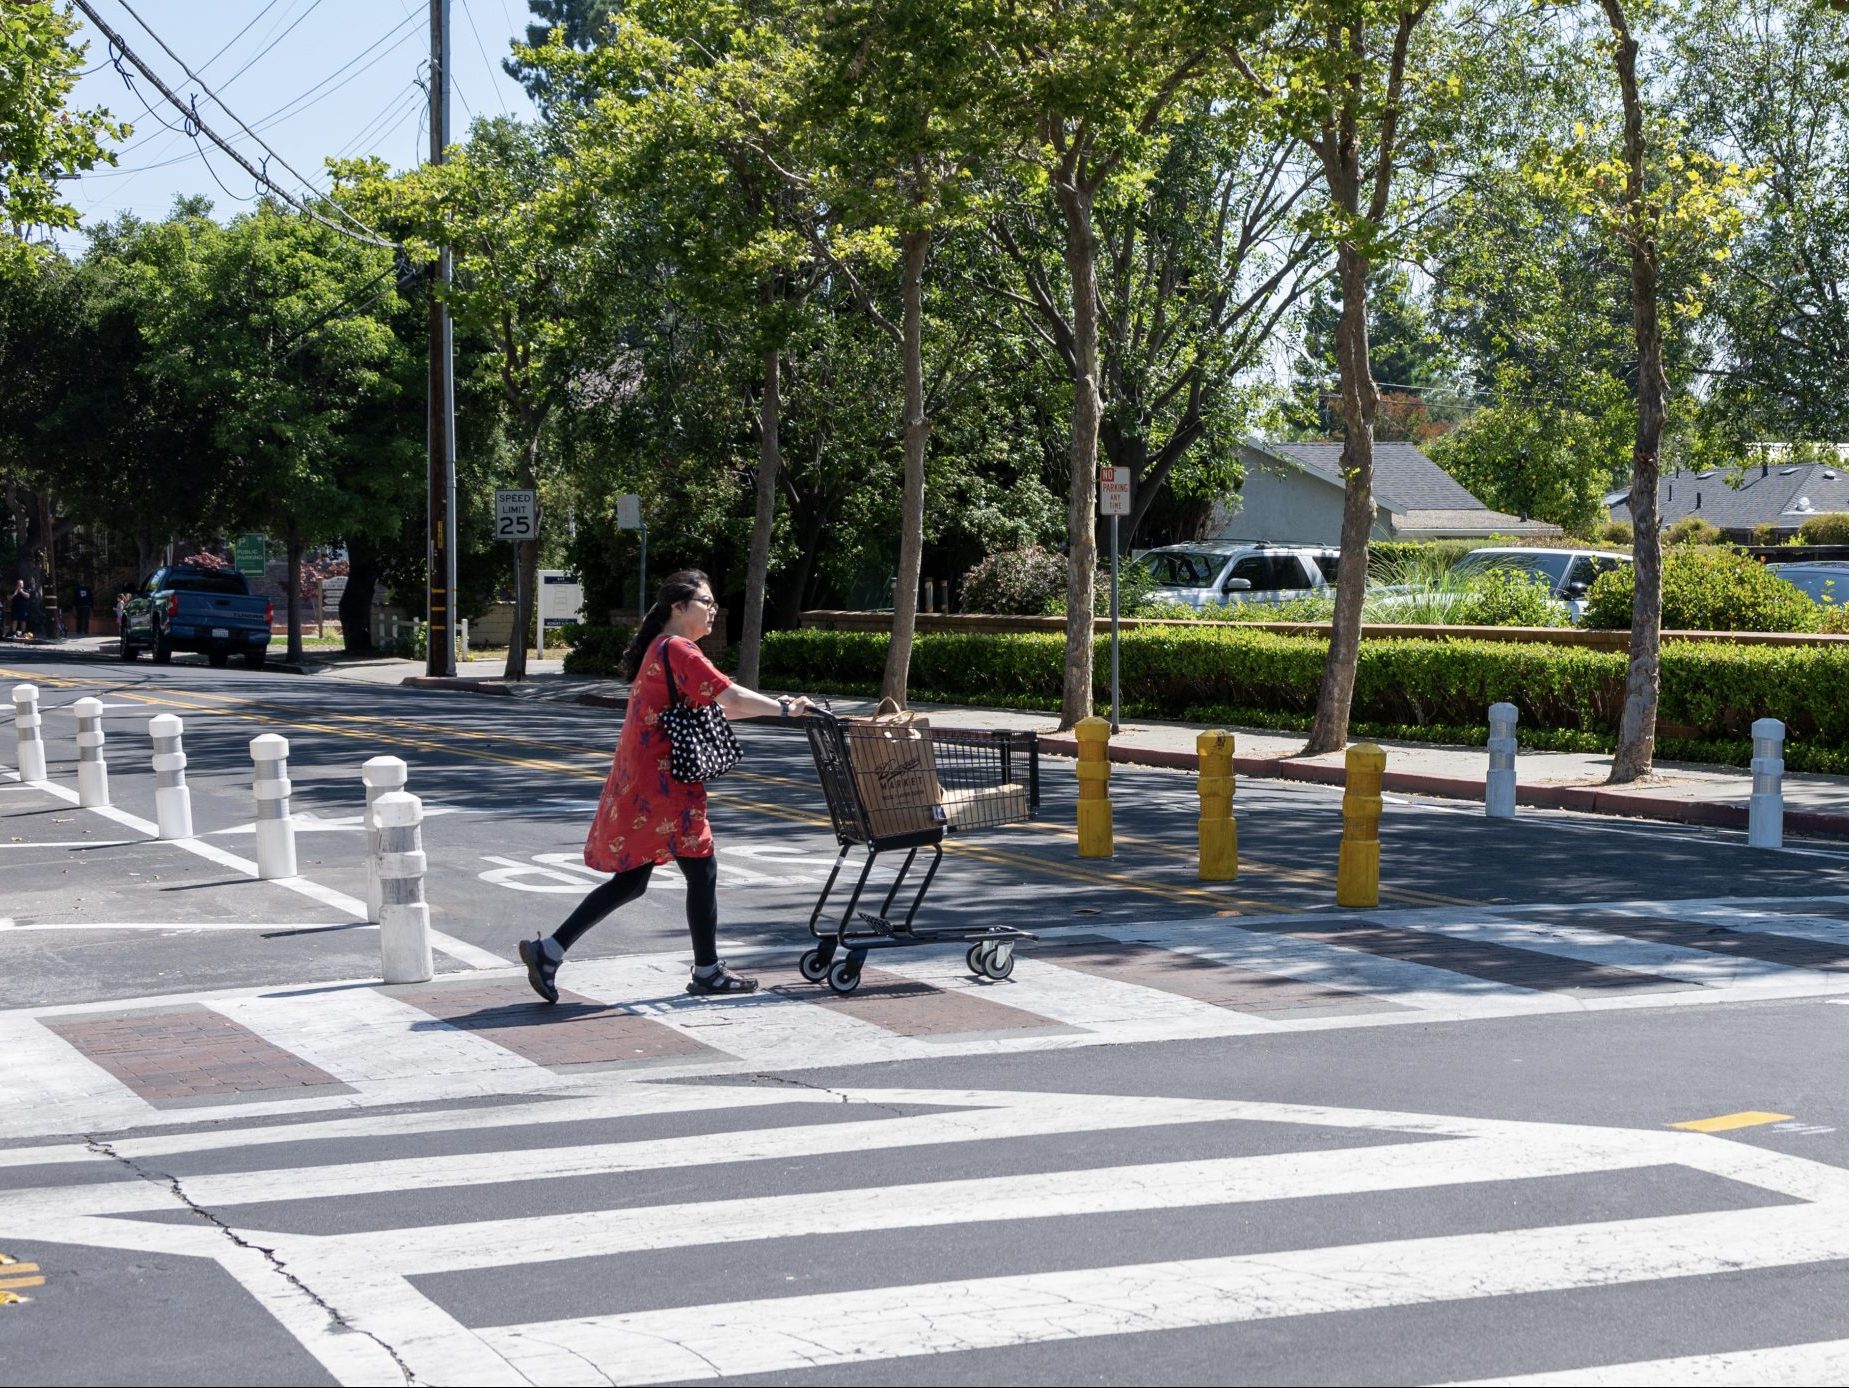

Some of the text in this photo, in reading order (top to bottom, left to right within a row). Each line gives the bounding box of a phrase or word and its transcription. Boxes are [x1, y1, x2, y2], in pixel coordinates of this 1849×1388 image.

[1102, 470, 1113, 481] NO
[1103, 483, 1128, 493] PARKING
[499, 494, 531, 503] SPEED
[502, 505, 527, 514] LIMIT
[1110, 502, 1122, 510] TIME
[500, 516, 530, 535] 25
[880, 776, 922, 790] MARKET
